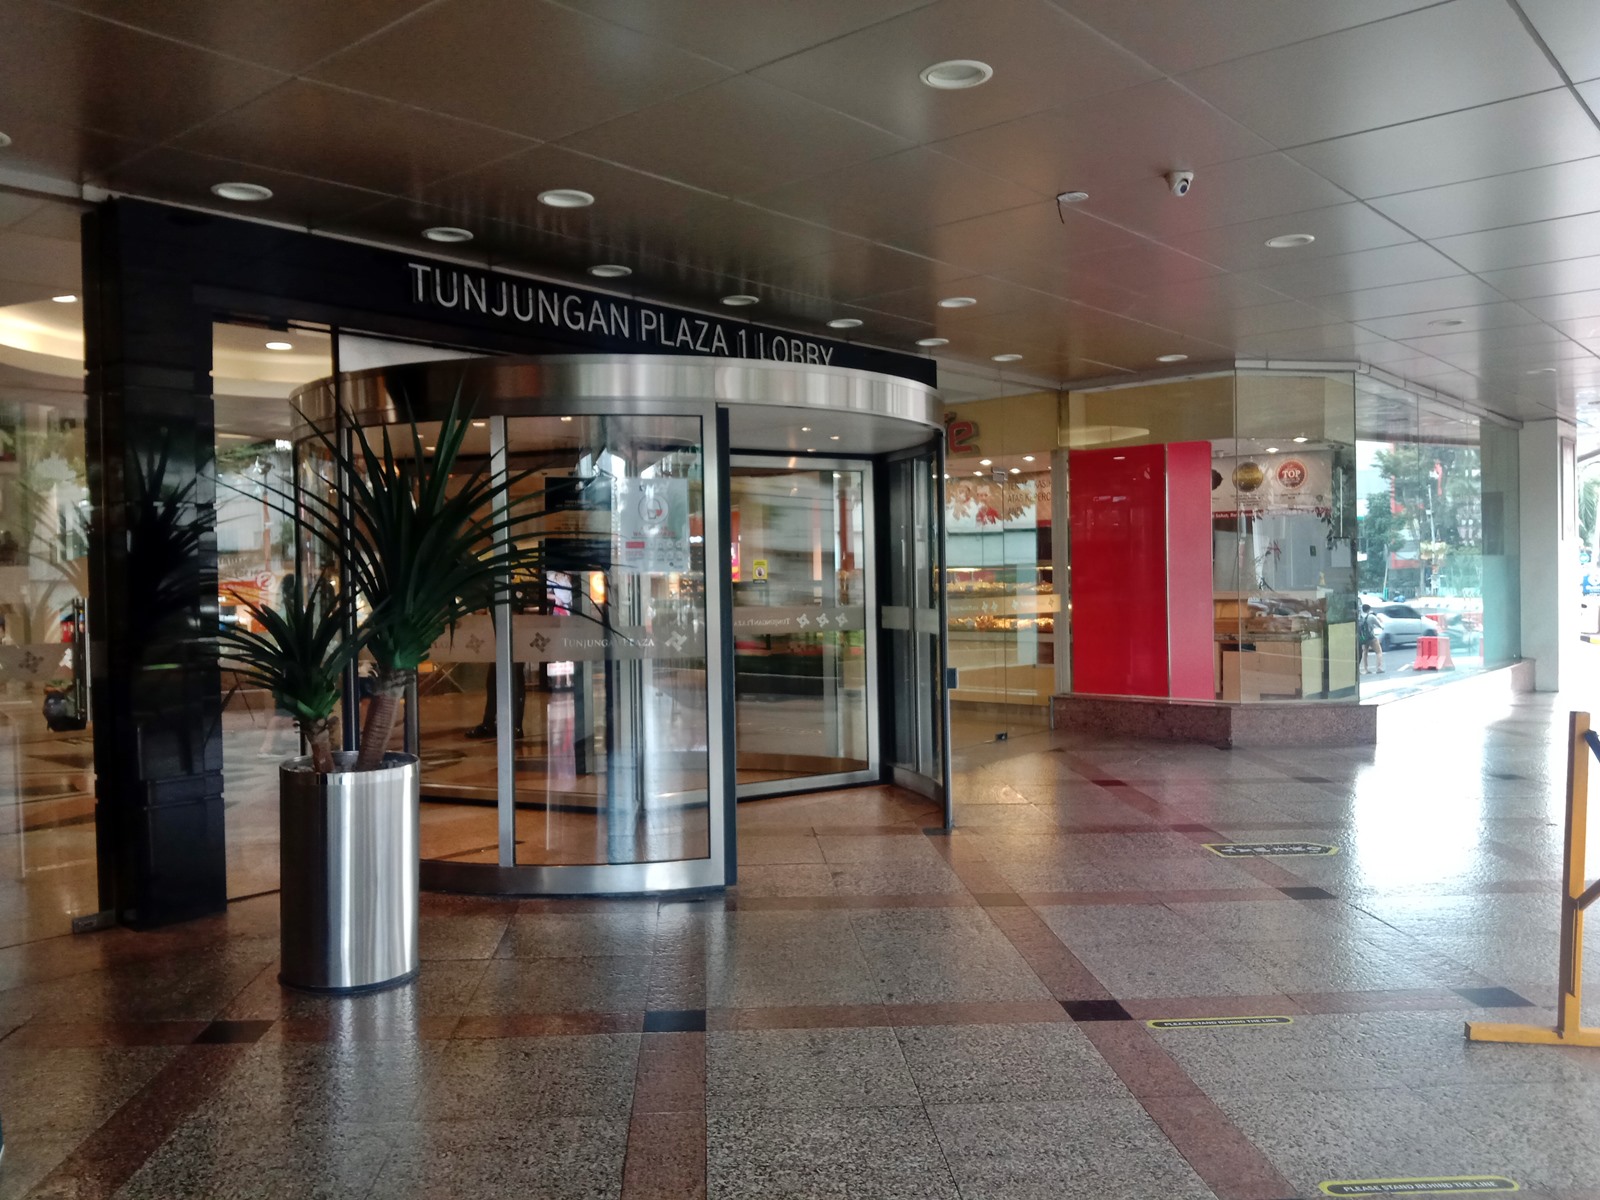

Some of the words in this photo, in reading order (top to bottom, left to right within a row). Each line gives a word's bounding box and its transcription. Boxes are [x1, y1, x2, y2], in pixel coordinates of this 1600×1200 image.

[408, 262, 630, 338] TUNJUNGAN
[640, 309, 729, 355] PLAZA
[738, 329, 747, 358] 1
[1281, 470, 1301, 479] TOP
[562, 638, 618, 649] TUNJUNG
